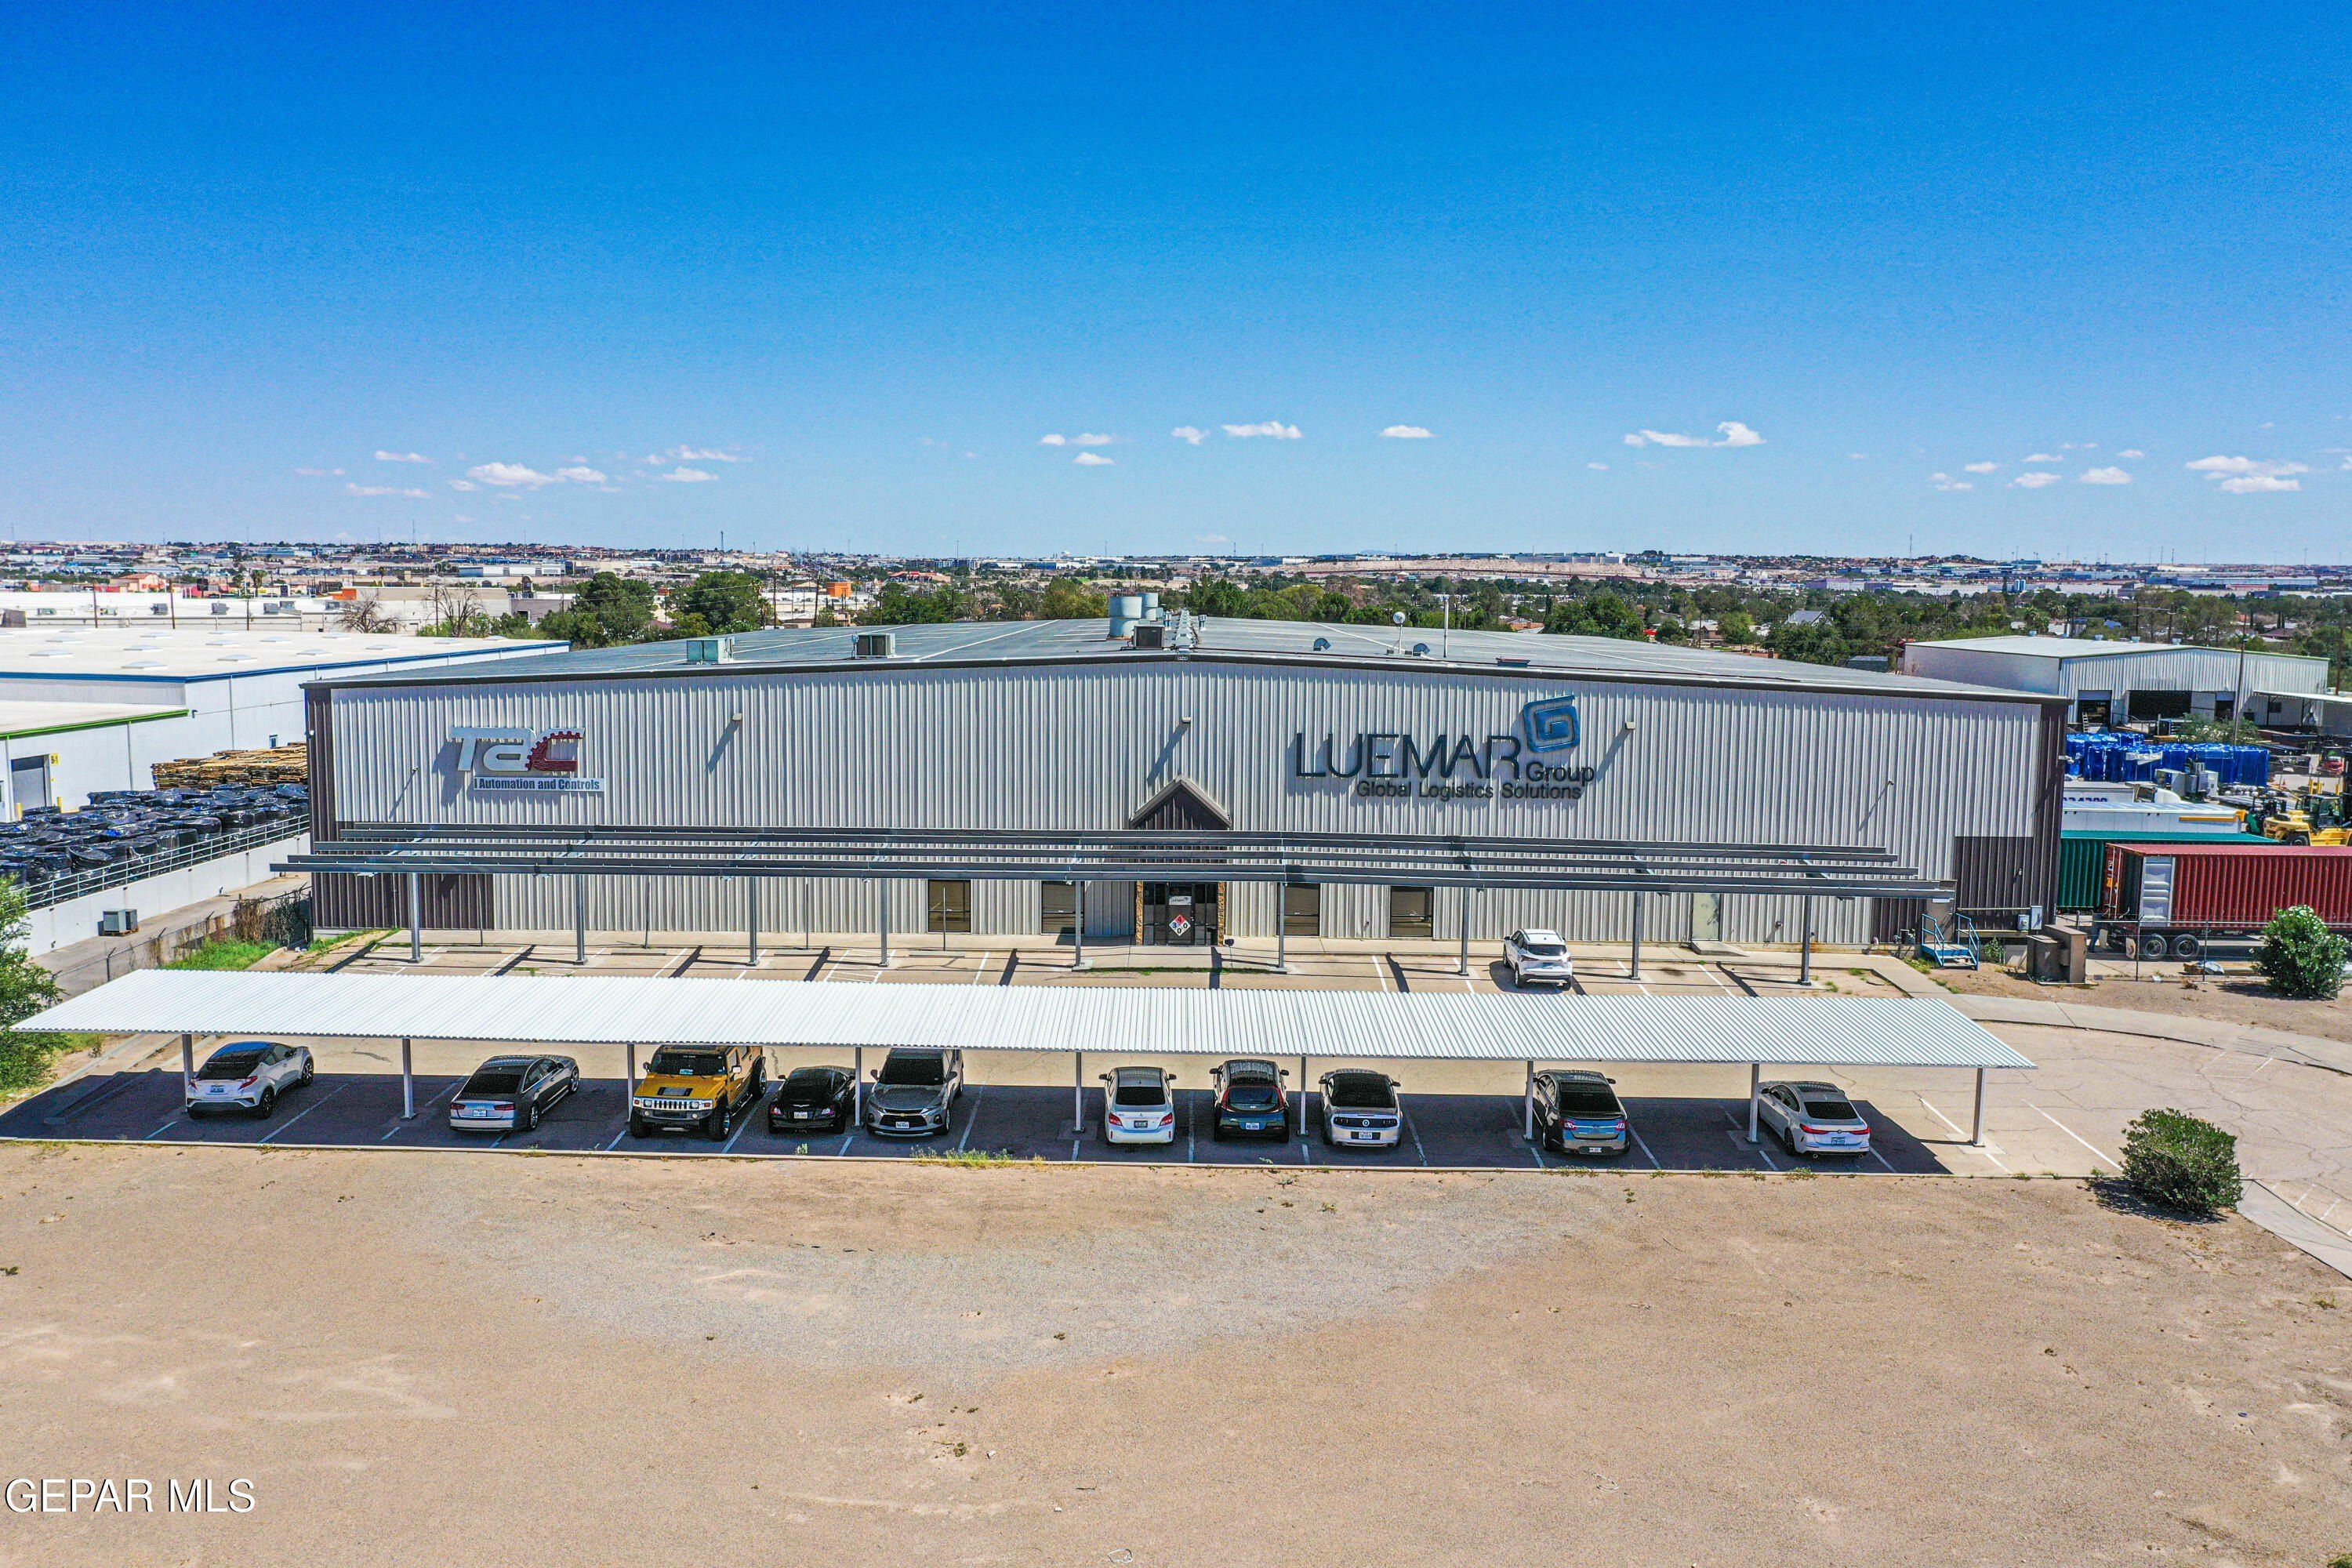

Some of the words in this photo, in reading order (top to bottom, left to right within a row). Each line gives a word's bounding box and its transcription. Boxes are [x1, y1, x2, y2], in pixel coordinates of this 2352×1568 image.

[1295, 732, 1522, 779] LUEMAR
[479, 778, 535, 789] Automation
[538, 779, 557, 789] and
[558, 779, 600, 790] Controls
[1526, 761, 1595, 786] Group
[1356, 781, 1411, 797] Global
[1418, 782, 1494, 801] Logistics
[1501, 782, 1582, 799] Solutions
